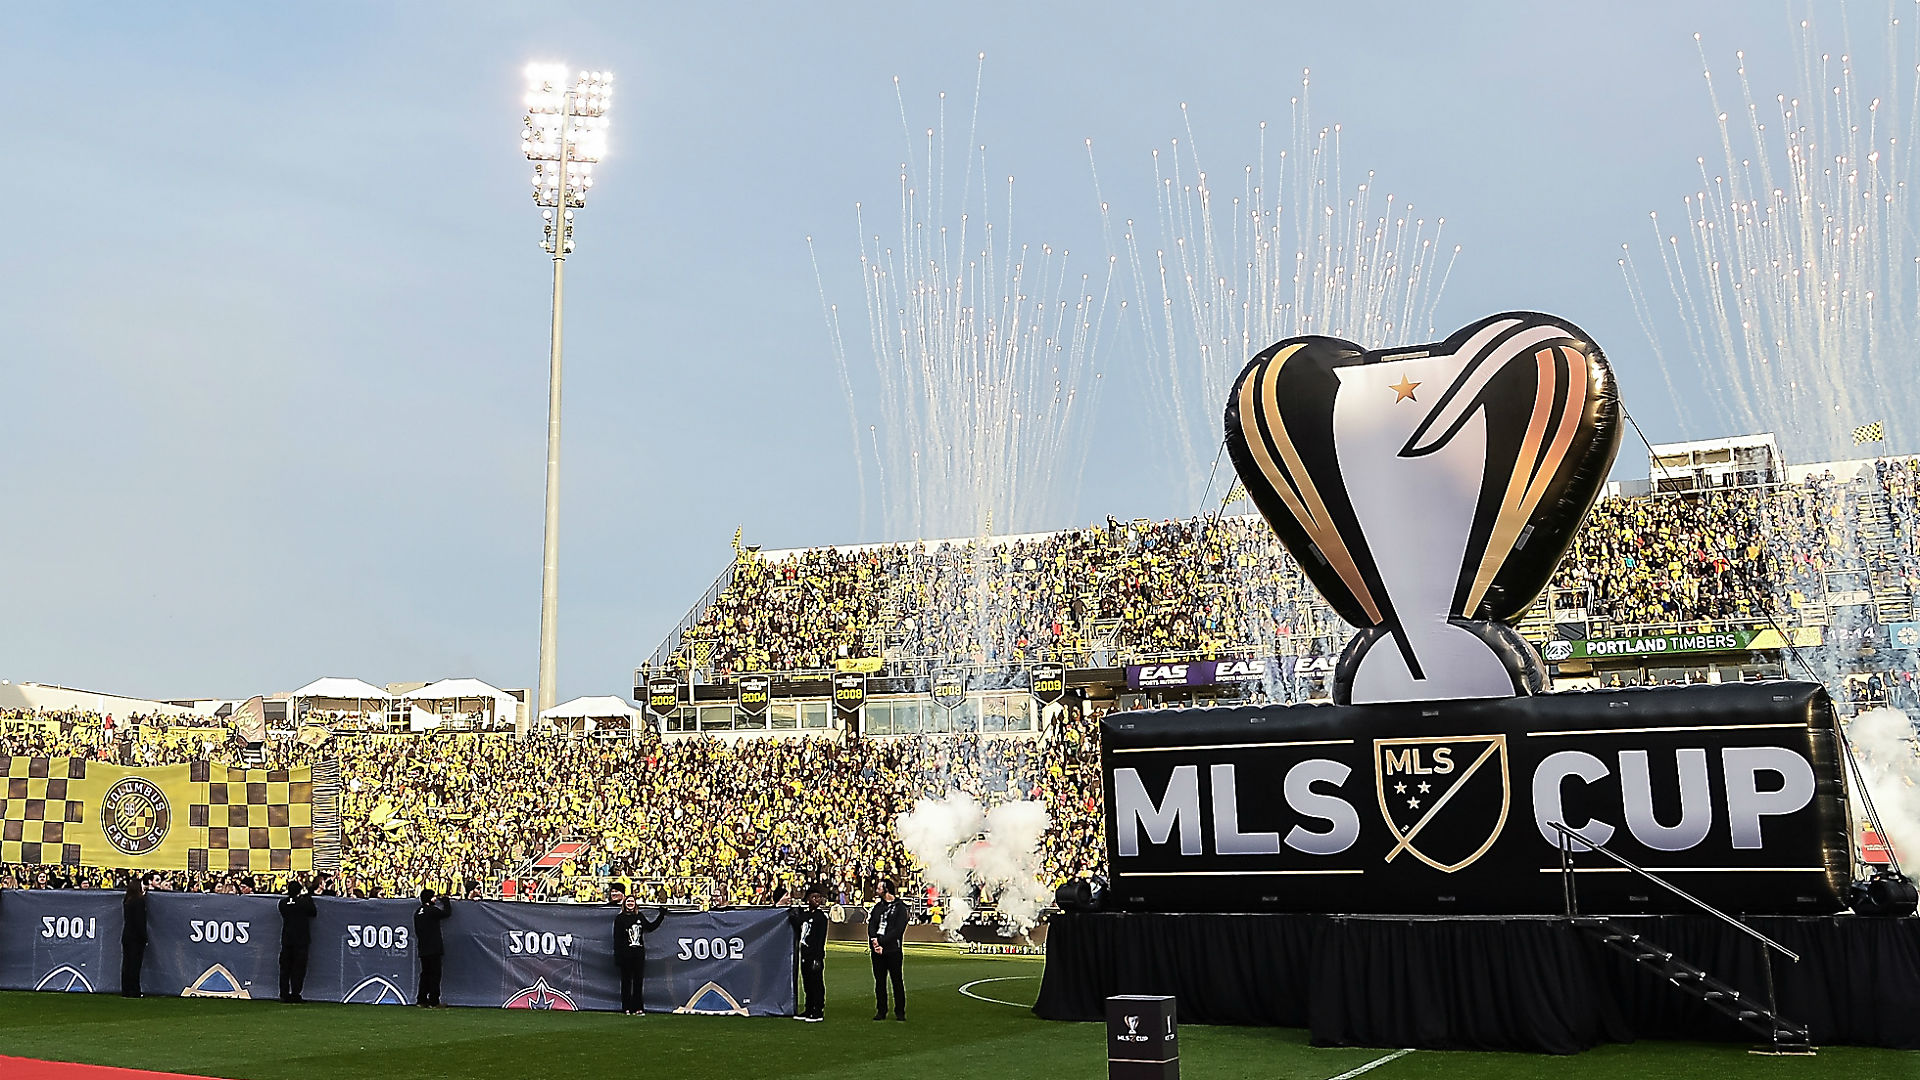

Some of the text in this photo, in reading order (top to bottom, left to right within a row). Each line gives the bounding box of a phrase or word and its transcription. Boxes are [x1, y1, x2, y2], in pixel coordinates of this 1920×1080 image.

[1586, 634, 1737, 655] PORTLAND TIMBERS
[1139, 665, 1190, 680] EAS
[1215, 661, 1267, 676] EAS
[651, 695, 676, 706] 2002
[741, 692, 767, 703] 2004
[837, 688, 863, 700] 2008
[1385, 747, 1455, 775] MLS
[106, 782, 166, 812] COLUMBUS
[1113, 746, 1816, 857] MLS CUP
[107, 824, 164, 851] CREW SC
